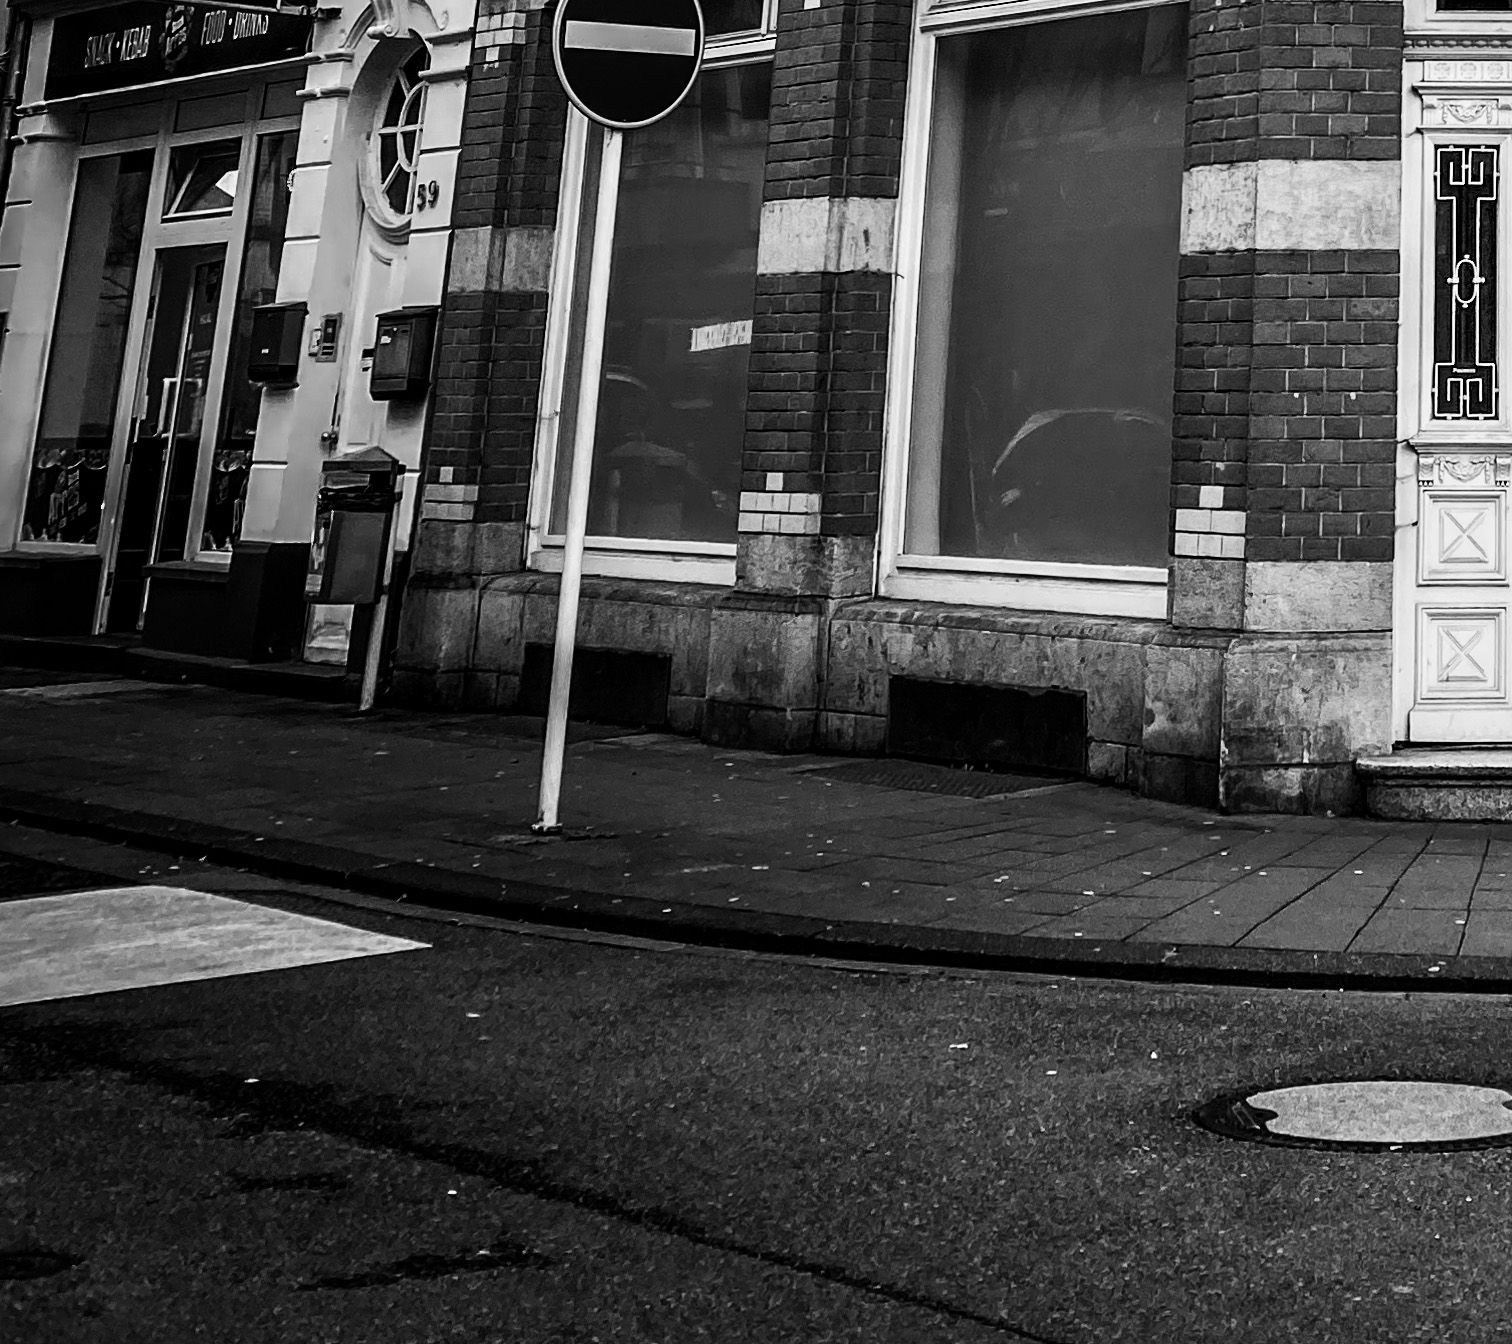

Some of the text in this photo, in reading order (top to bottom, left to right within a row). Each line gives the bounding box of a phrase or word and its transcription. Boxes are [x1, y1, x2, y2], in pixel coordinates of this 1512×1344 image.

[120, 25, 151, 62] KEBAB
[201, 10, 227, 46] FOOD
[233, 11, 269, 40] DRINKS
[417, 180, 440, 212] 59
